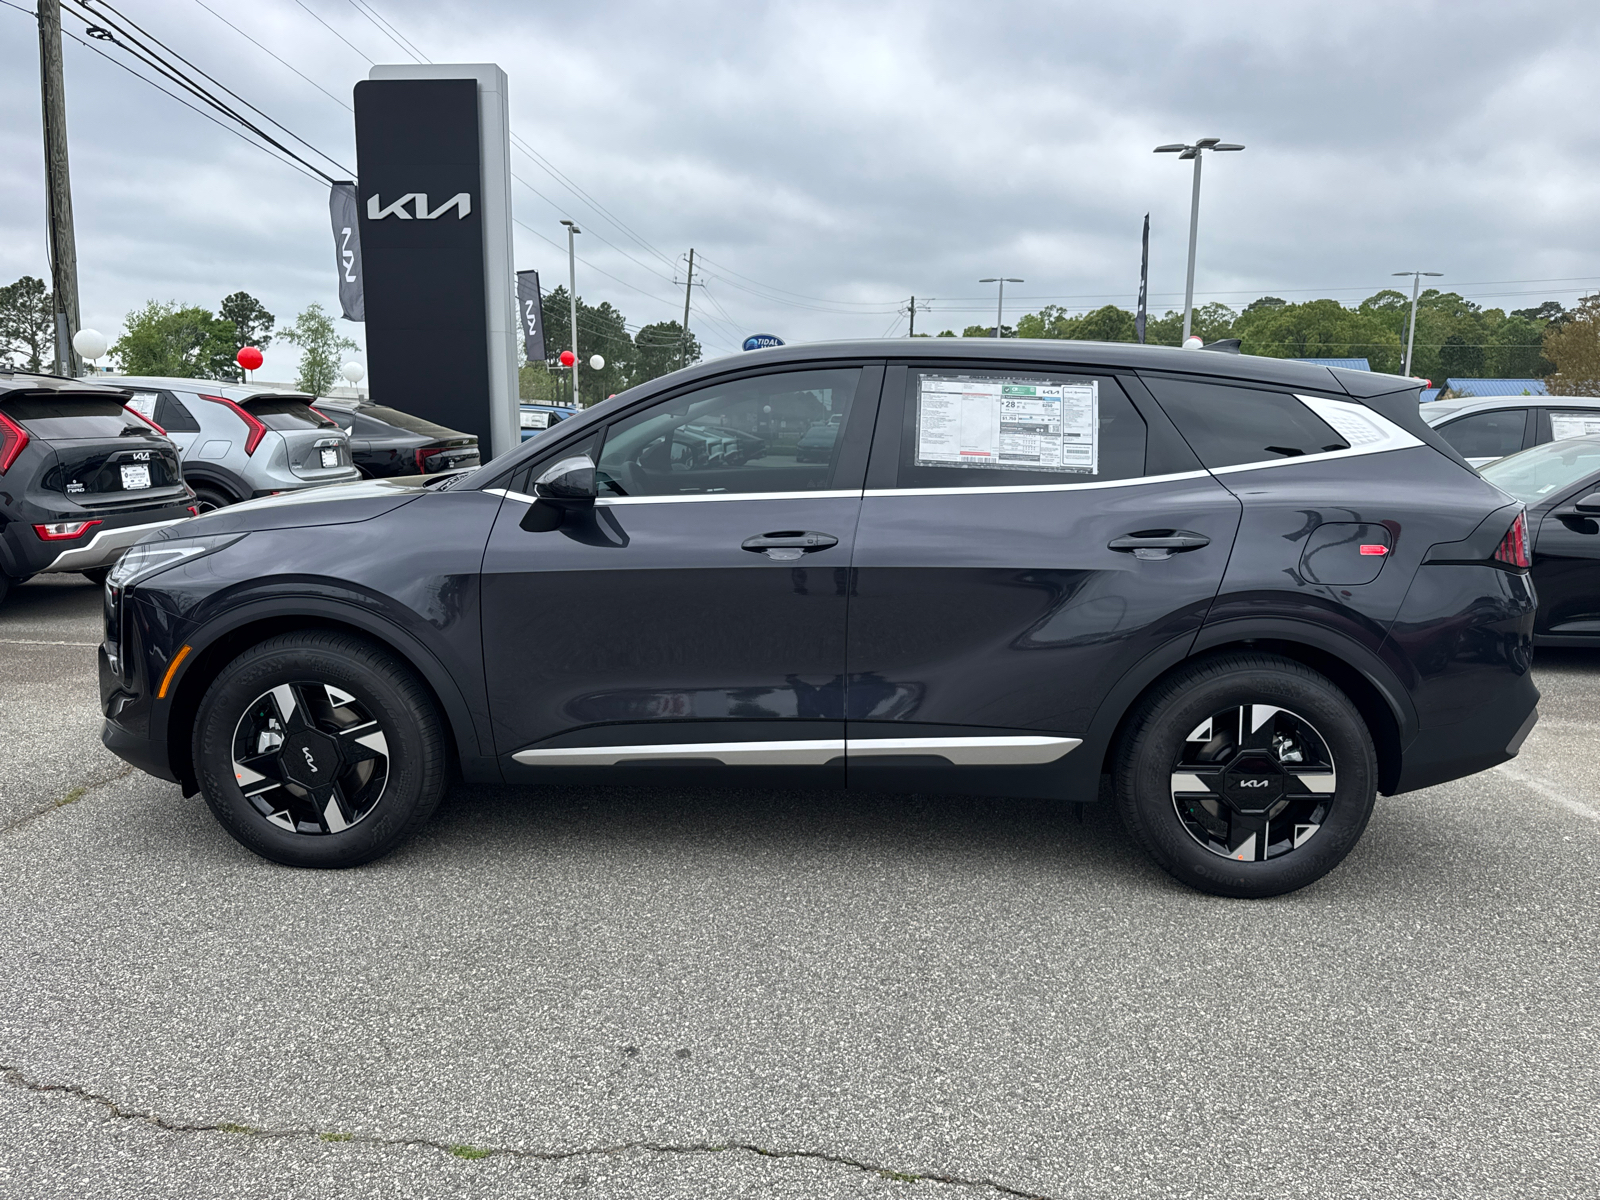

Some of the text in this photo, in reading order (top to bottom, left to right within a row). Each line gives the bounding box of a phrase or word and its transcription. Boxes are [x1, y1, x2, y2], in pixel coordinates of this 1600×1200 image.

[366, 192, 472, 221] KIA
[757, 338, 779, 346] TIDAL
[1005, 400, 1016, 409] 28
[132, 452, 150, 460] KIA
[302, 746, 318, 773] KIA
